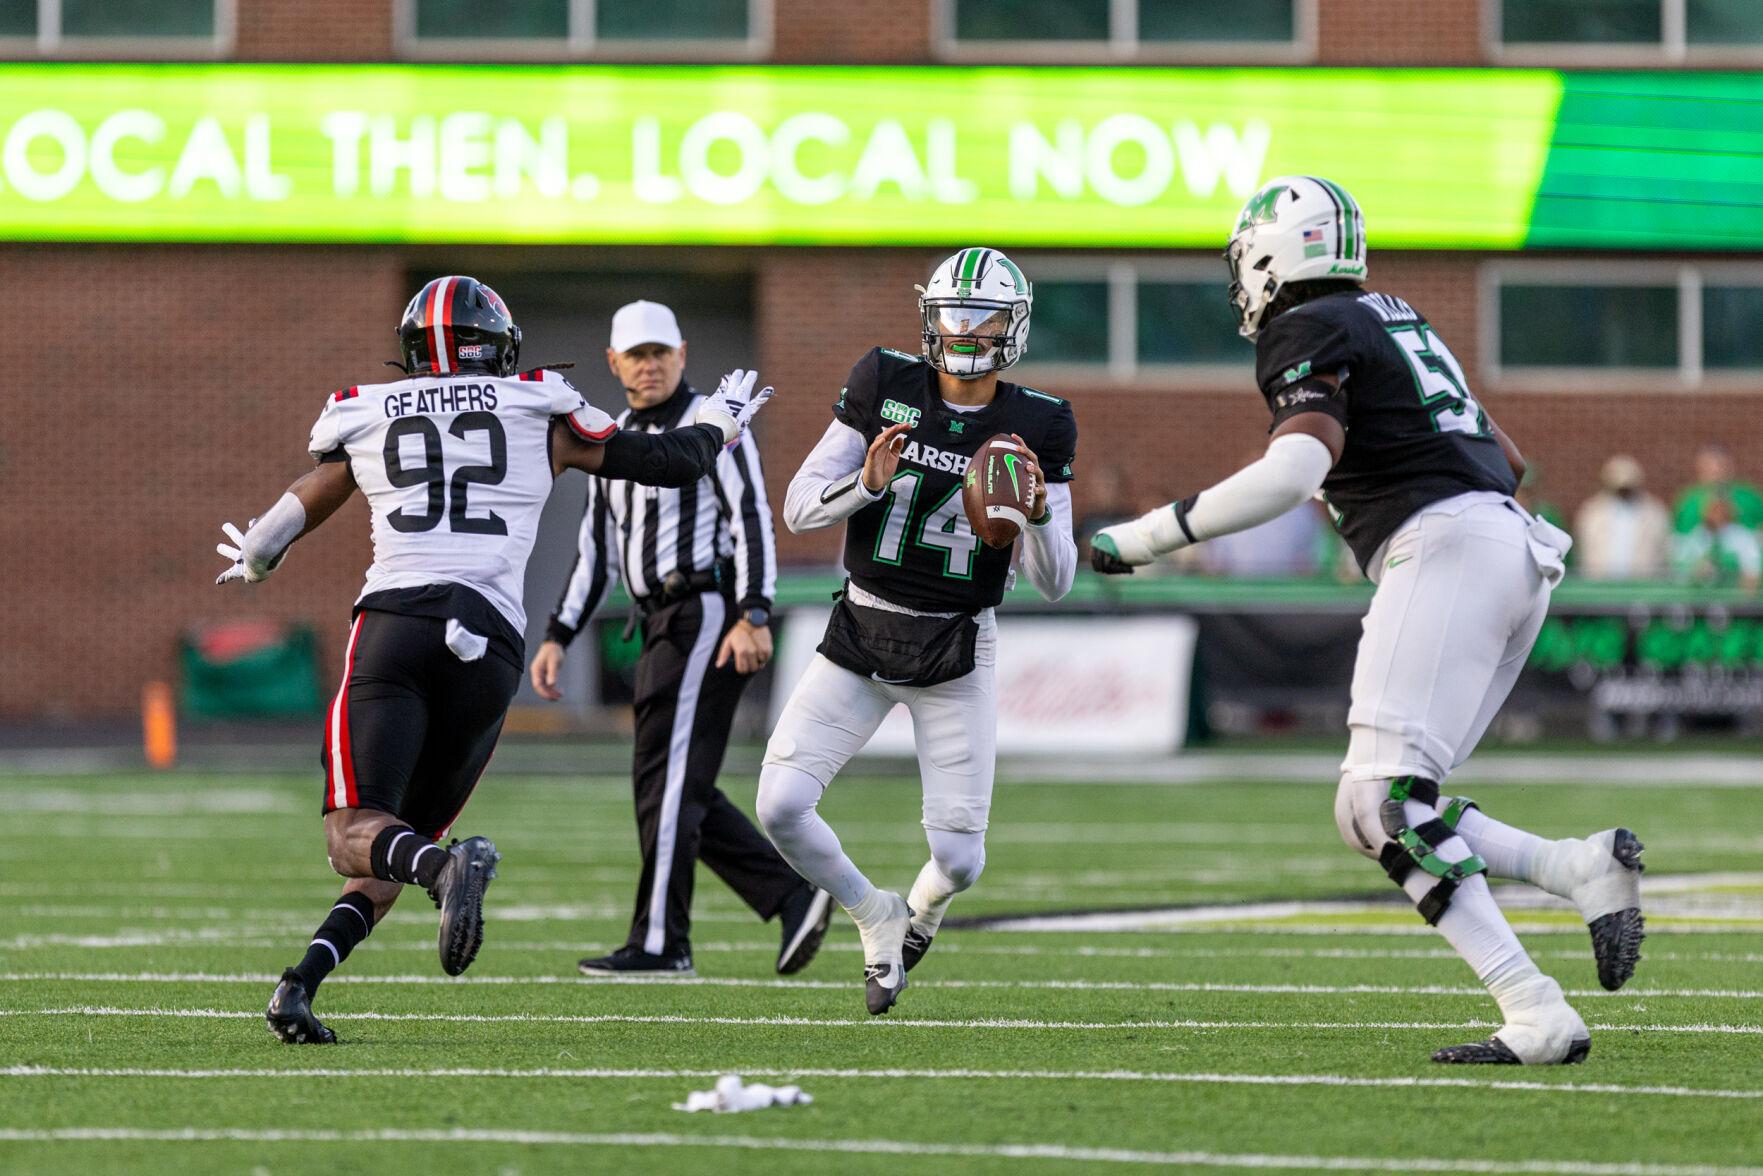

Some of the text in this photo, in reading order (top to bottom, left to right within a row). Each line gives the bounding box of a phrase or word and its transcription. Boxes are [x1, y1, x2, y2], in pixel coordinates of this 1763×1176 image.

[0, 109, 1271, 206] OCAL THEN. LOCAL NOW
[384, 384, 498, 418] GEATHERS
[881, 398, 921, 428] SBC
[383, 410, 508, 536] 92
[873, 468, 982, 580] 14
